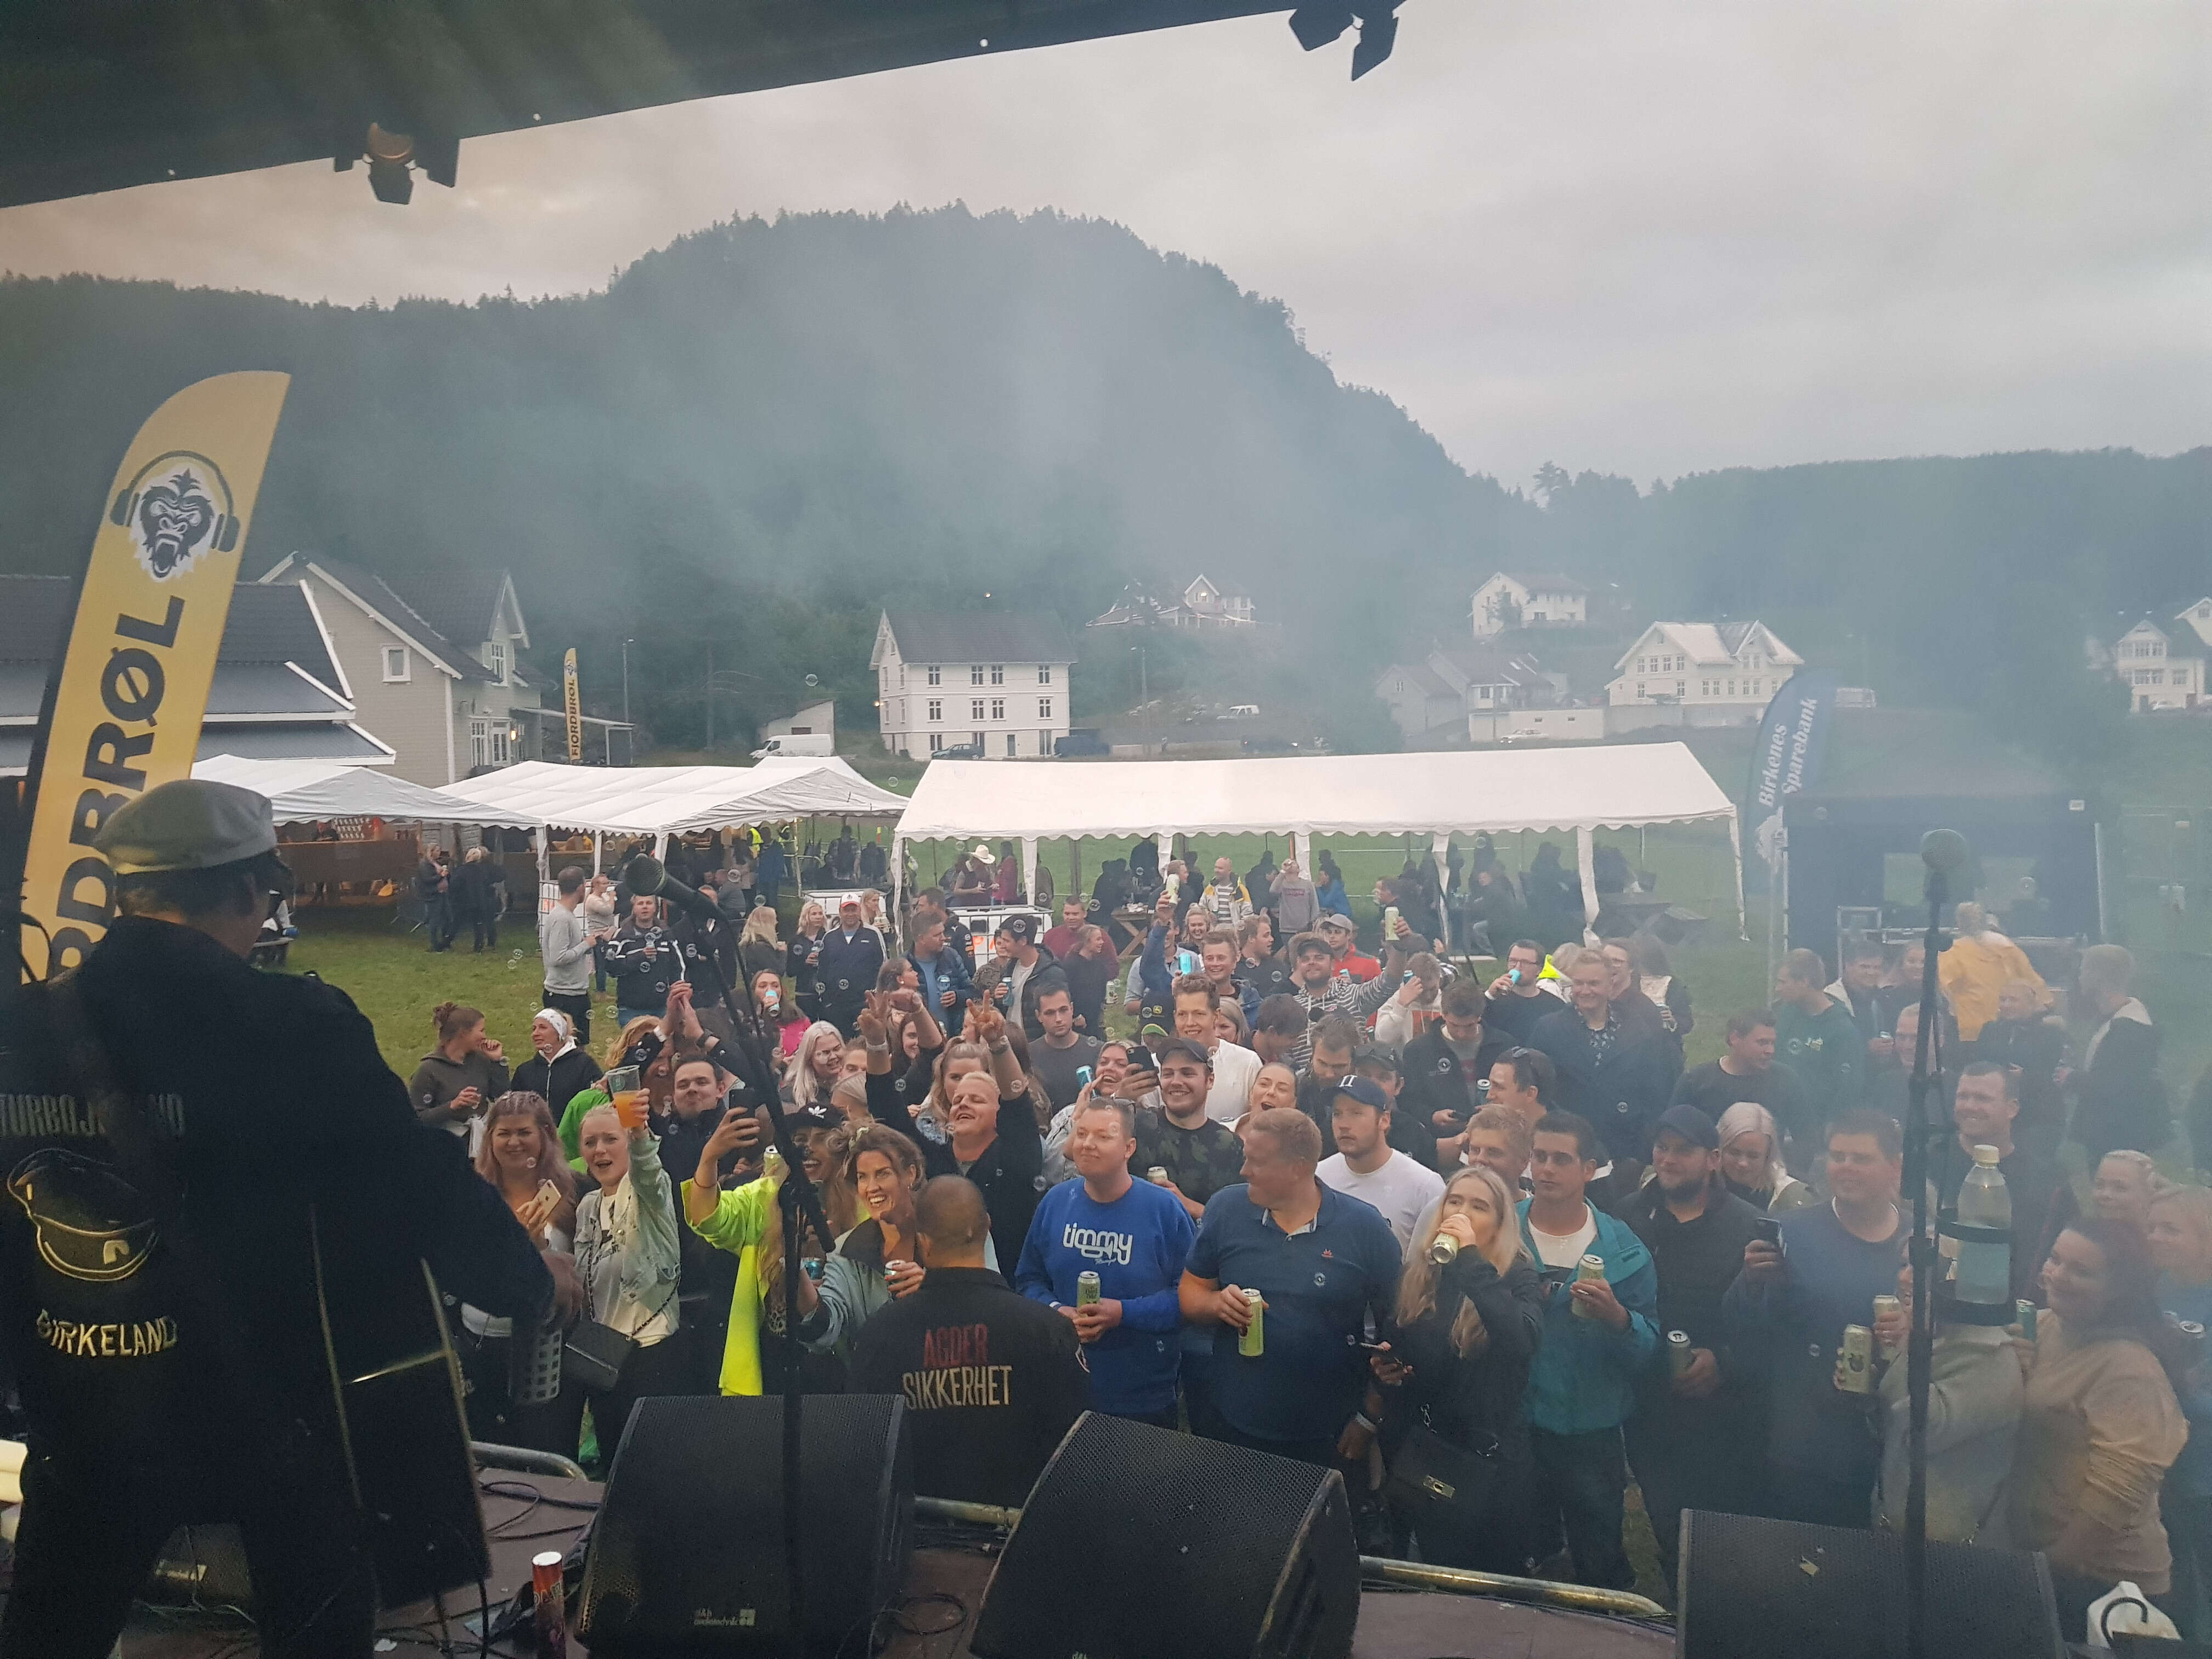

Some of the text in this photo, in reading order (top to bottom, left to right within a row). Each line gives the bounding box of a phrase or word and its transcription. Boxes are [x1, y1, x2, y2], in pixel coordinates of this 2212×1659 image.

[1758, 724, 1786, 808] Birkenes
[1781, 698, 1817, 793] Sparebank
[1063, 1222, 1133, 1265] timmy
[902, 1365, 1012, 1409] SIKKERHET
